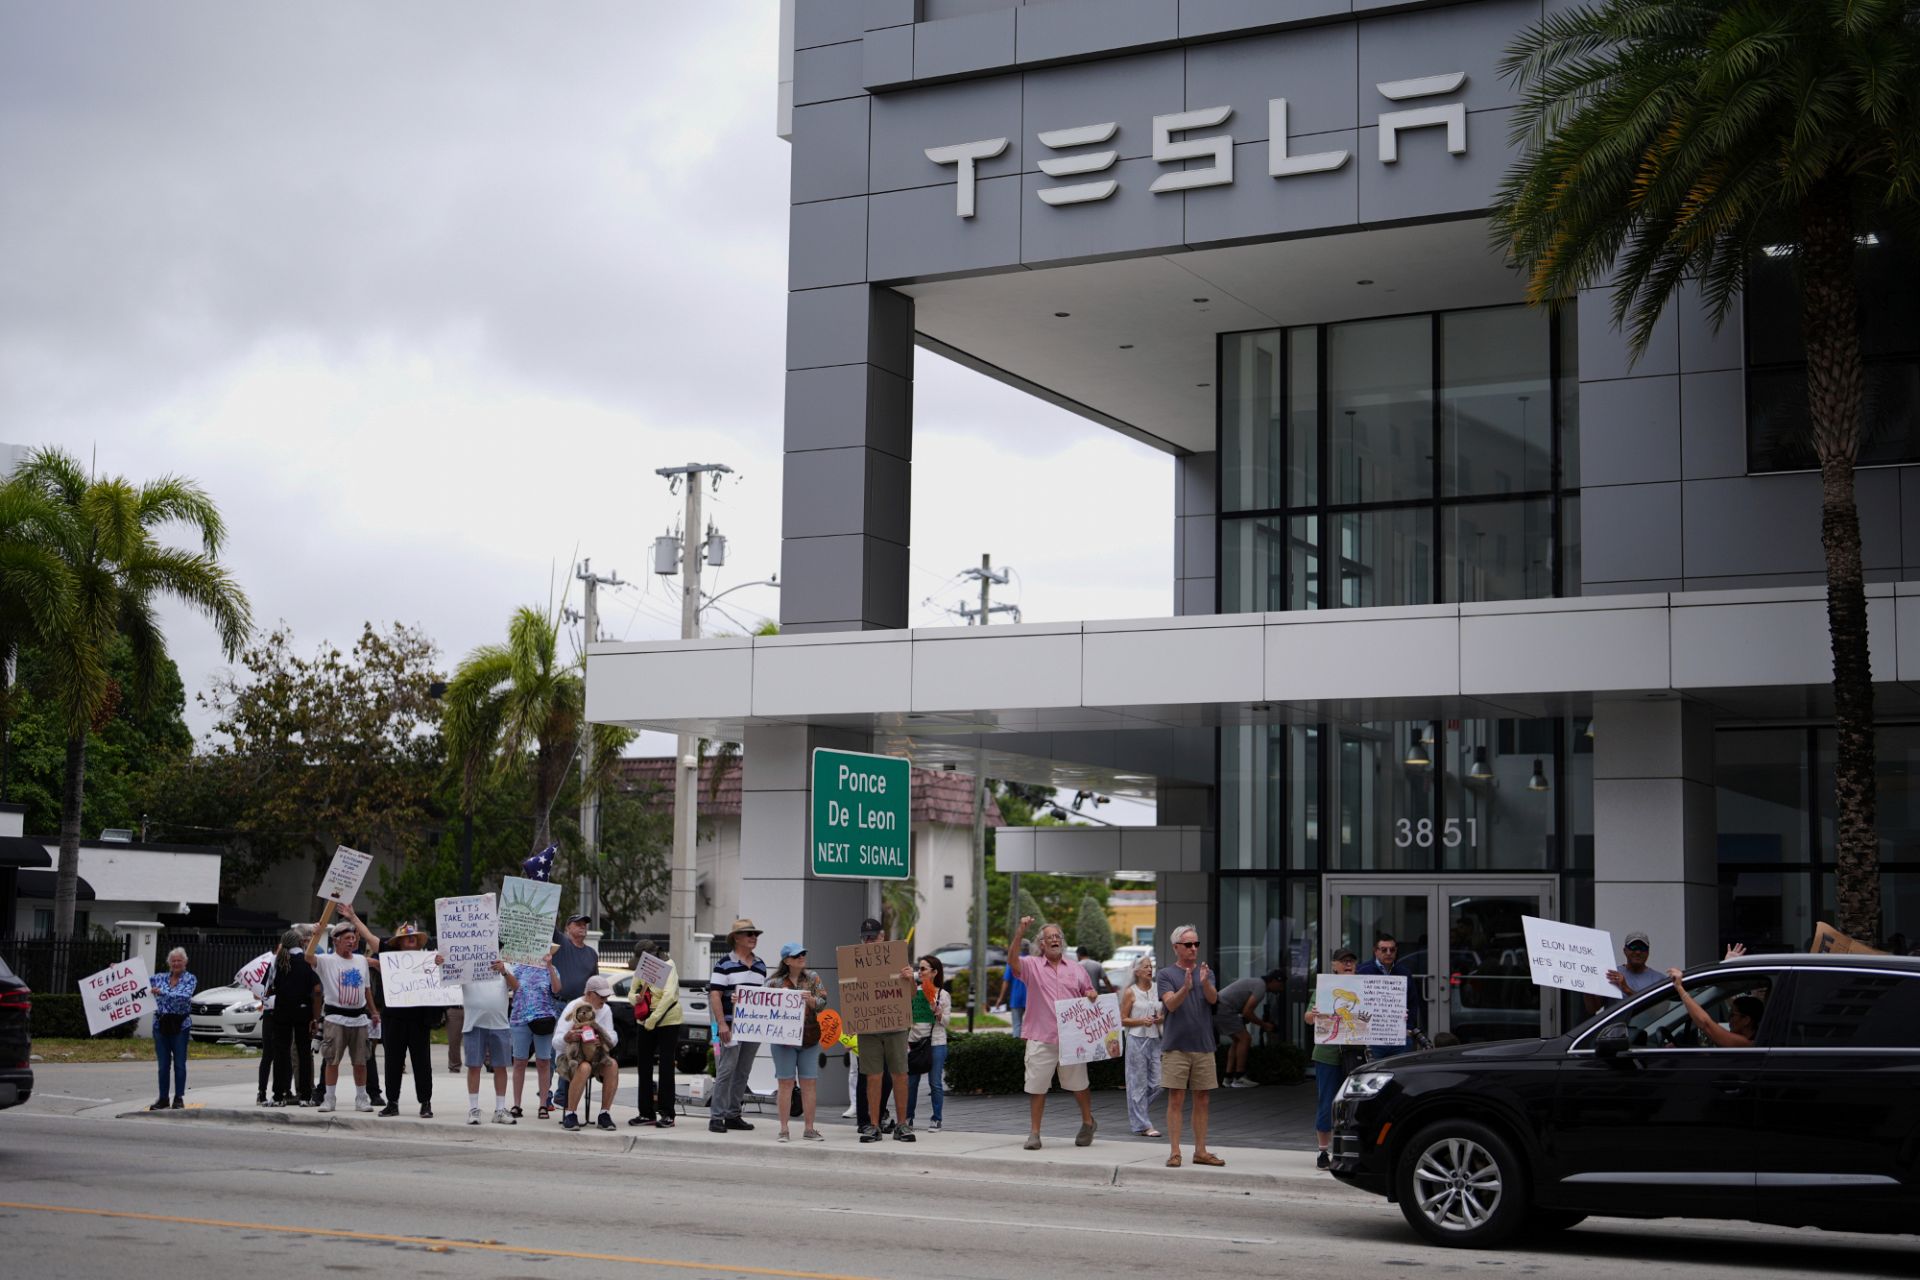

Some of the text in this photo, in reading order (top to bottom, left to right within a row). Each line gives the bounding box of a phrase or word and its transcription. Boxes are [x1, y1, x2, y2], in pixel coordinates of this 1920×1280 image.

[924, 72, 1466, 218] TESLA
[839, 765, 886, 794] Ponce
[829, 801, 895, 830] De Leon
[1395, 818, 1477, 847] 3851
[818, 842, 904, 866] NEXT SIGNAL
[443, 912, 490, 922] TAKE BACK
[441, 929, 494, 939] DEMOCRACY
[450, 944, 487, 953] FROM THE
[854, 945, 890, 957] ELON
[1541, 939, 1565, 951] ELON
[387, 953, 414, 969] NO
[449, 951, 497, 962] OLIGARCHS
[855, 955, 891, 968] MUSK
[1532, 957, 1599, 975] HE'S NOT ONE
[842, 981, 869, 992] MIND
[1552, 975, 1565, 984] OF
[98, 980, 138, 1001] GREED
[99, 987, 148, 1012] WE WILL NOT
[737, 989, 783, 1007] PROTECT
[874, 988, 903, 1000] DAMN
[109, 1003, 142, 1021] HEED
[1060, 1000, 1086, 1024] SHAME
[1075, 1001, 1104, 1029] SHAME
[821, 1018, 840, 1044] TRUMP
[847, 1018, 870, 1033] NOT
[1084, 1009, 1118, 1044] SHAME
